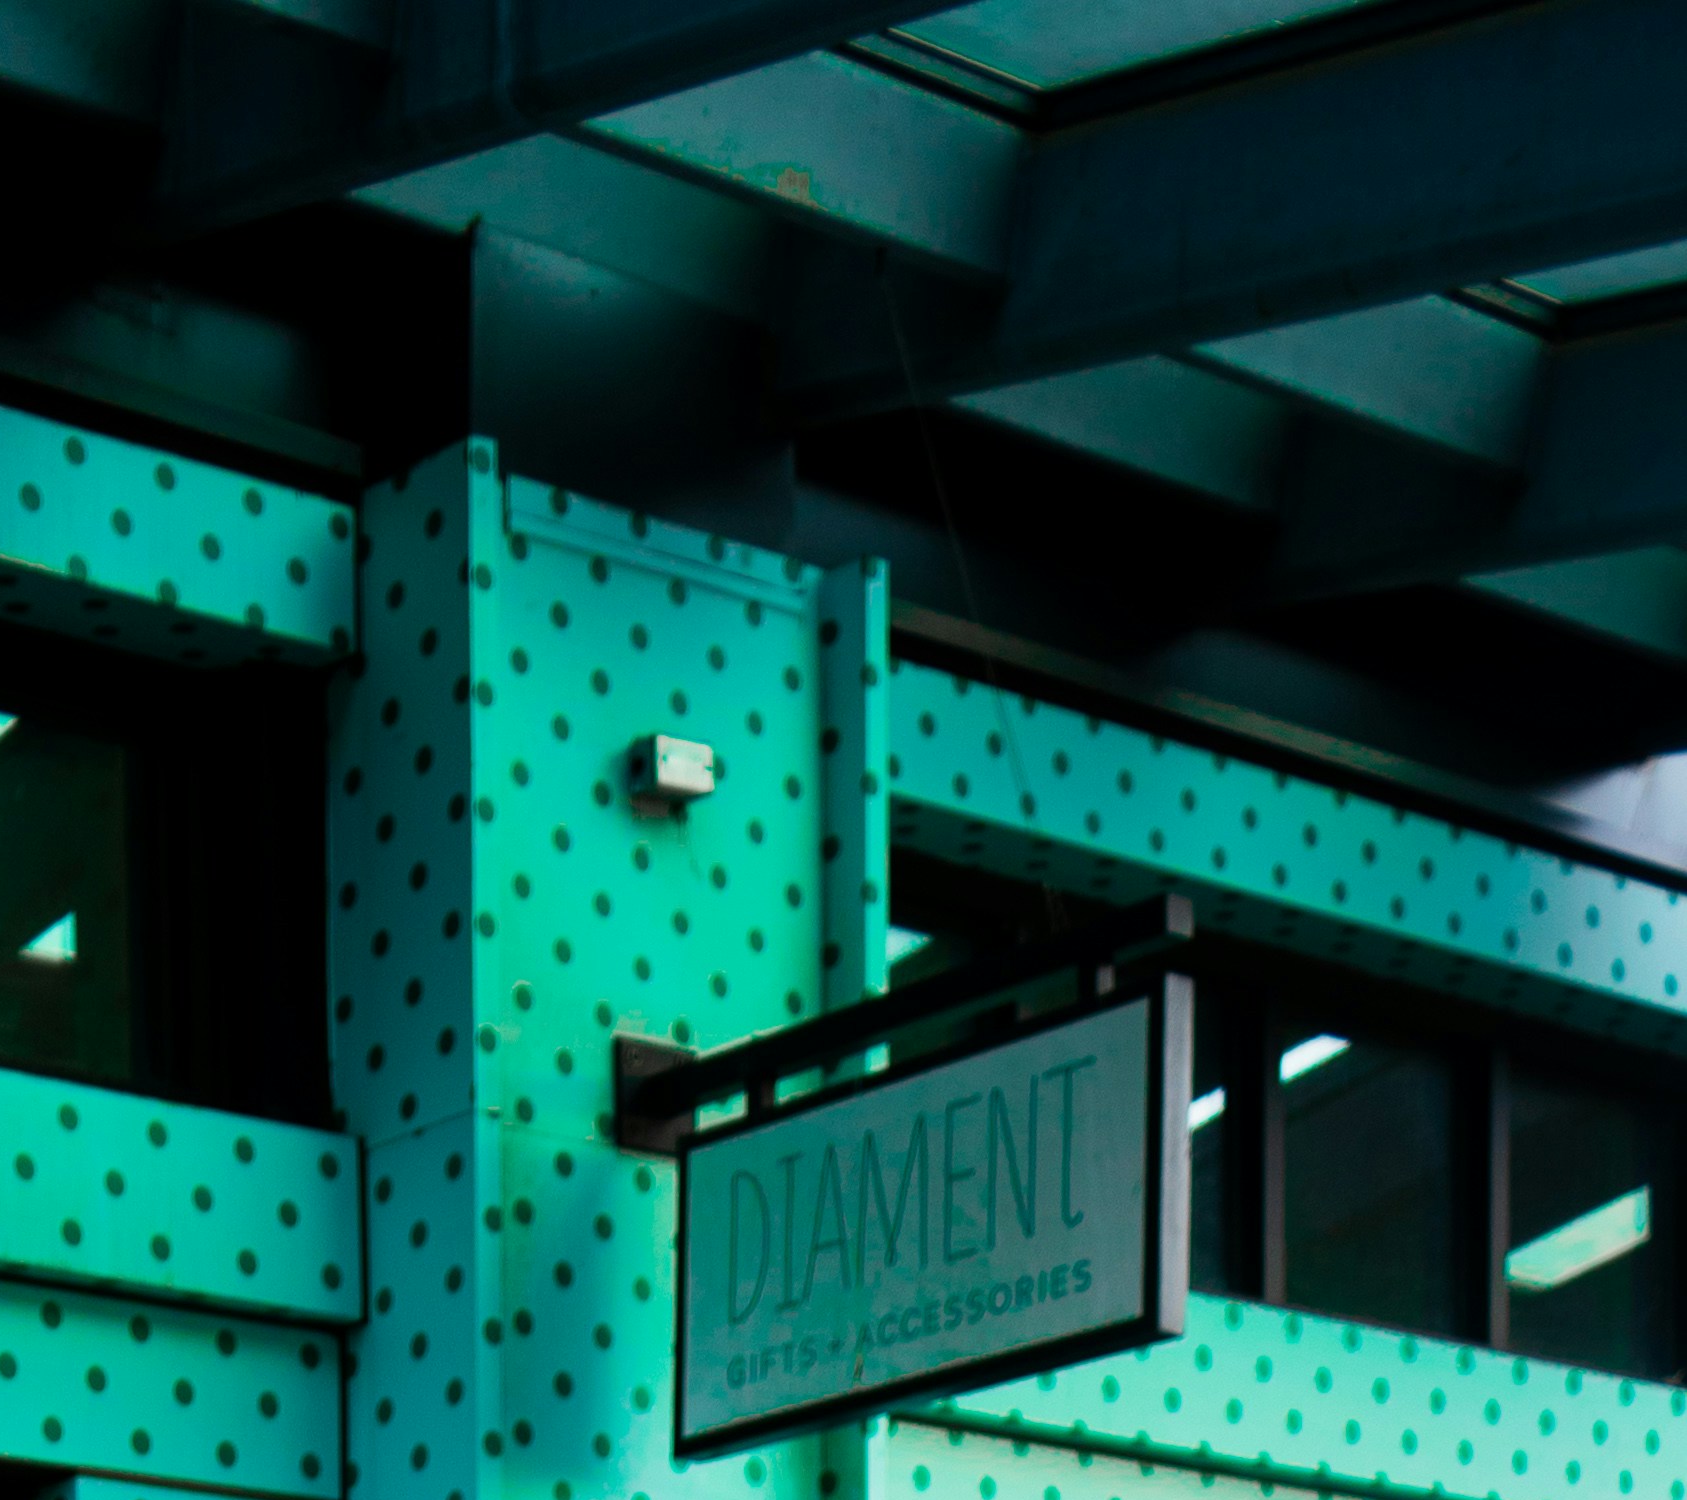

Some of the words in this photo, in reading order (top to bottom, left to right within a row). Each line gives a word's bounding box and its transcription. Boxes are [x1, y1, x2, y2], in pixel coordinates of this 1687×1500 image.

[727, 1056, 1097, 1328] DIAMENT
[726, 1342, 819, 1390] GIFTS
[857, 1259, 1094, 1351] ACCESSORIES
